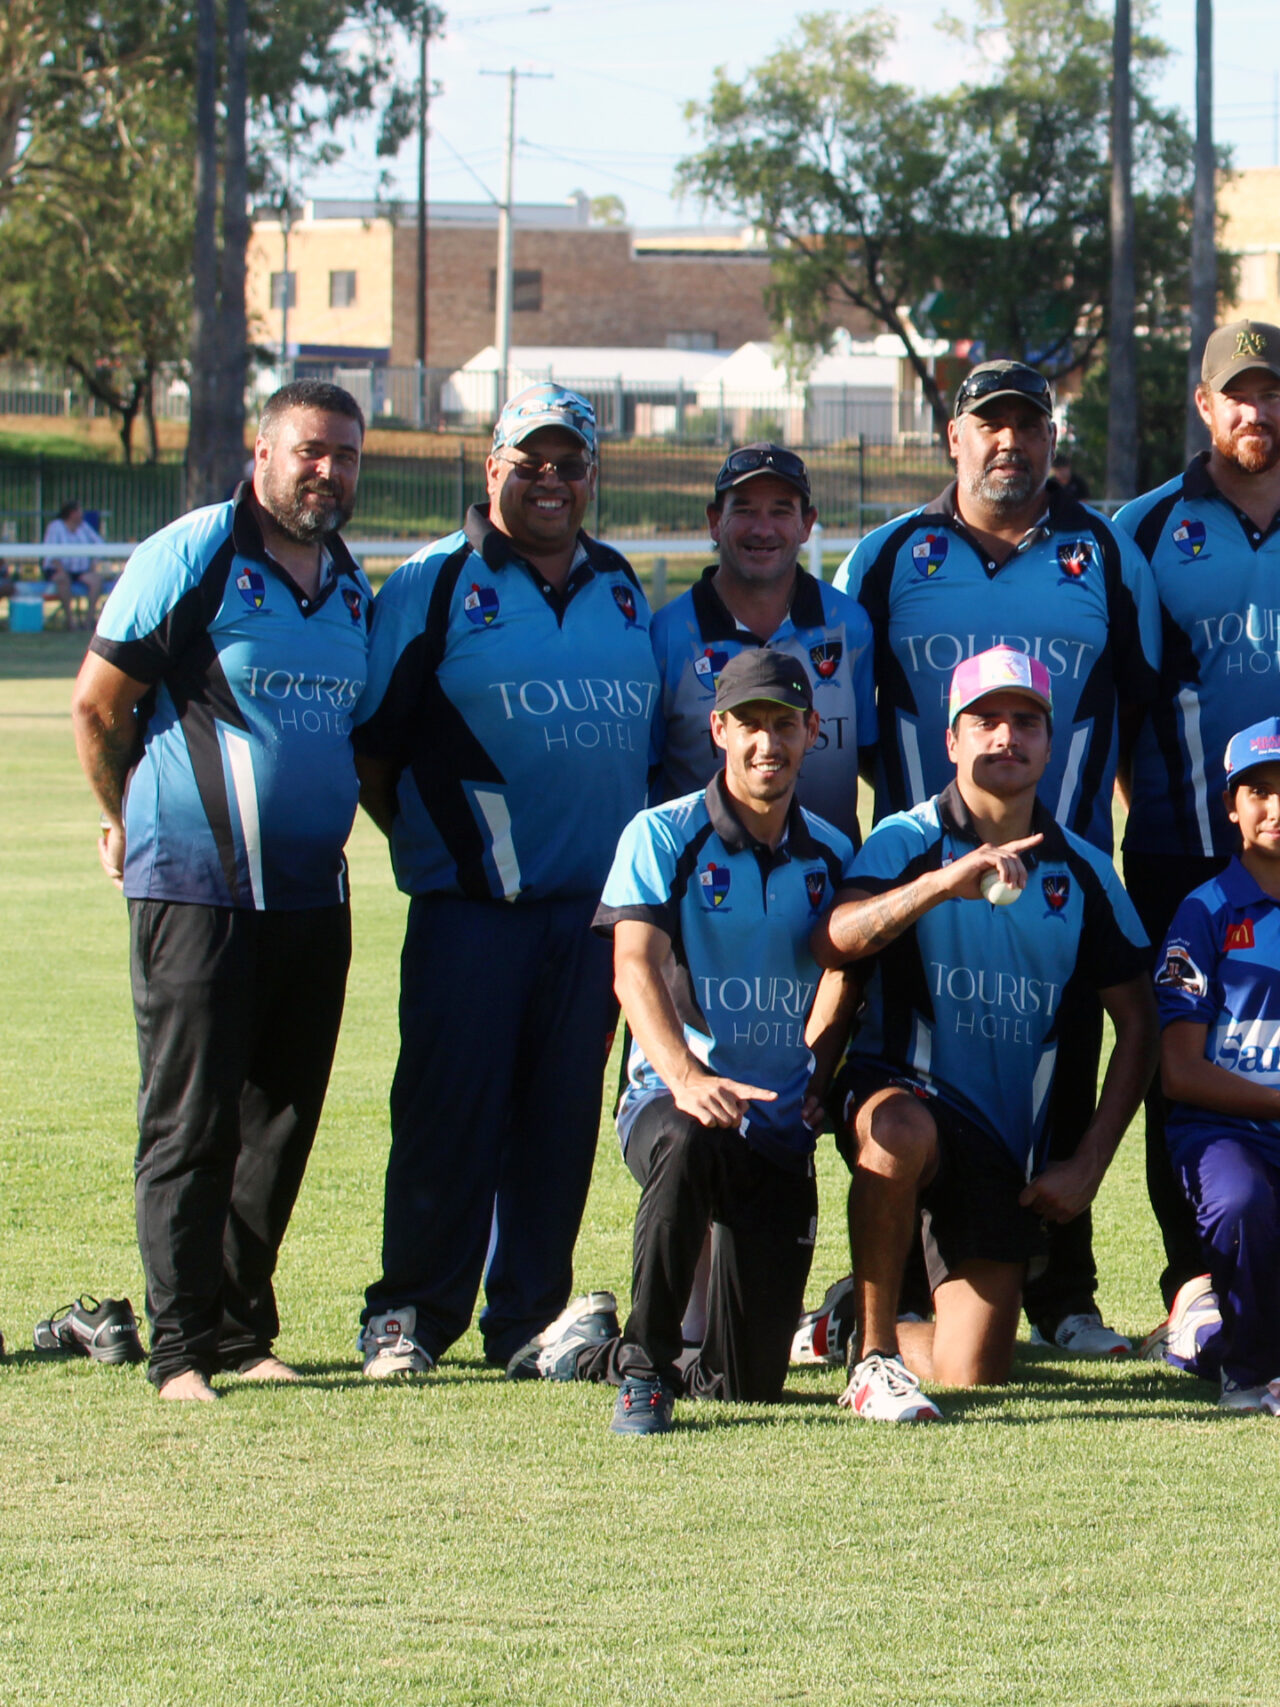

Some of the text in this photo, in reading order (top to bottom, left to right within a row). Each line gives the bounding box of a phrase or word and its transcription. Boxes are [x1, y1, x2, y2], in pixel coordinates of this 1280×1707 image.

[242, 665, 366, 710] TOURIS
[488, 679, 658, 720] TOURIST
[543, 721, 635, 752] HOTEL
[698, 976, 815, 1018] TOURIT
[930, 961, 1060, 1016] TOURIST
[733, 1021, 804, 1048] HOTEL
[955, 1010, 1033, 1045] HOTEL
